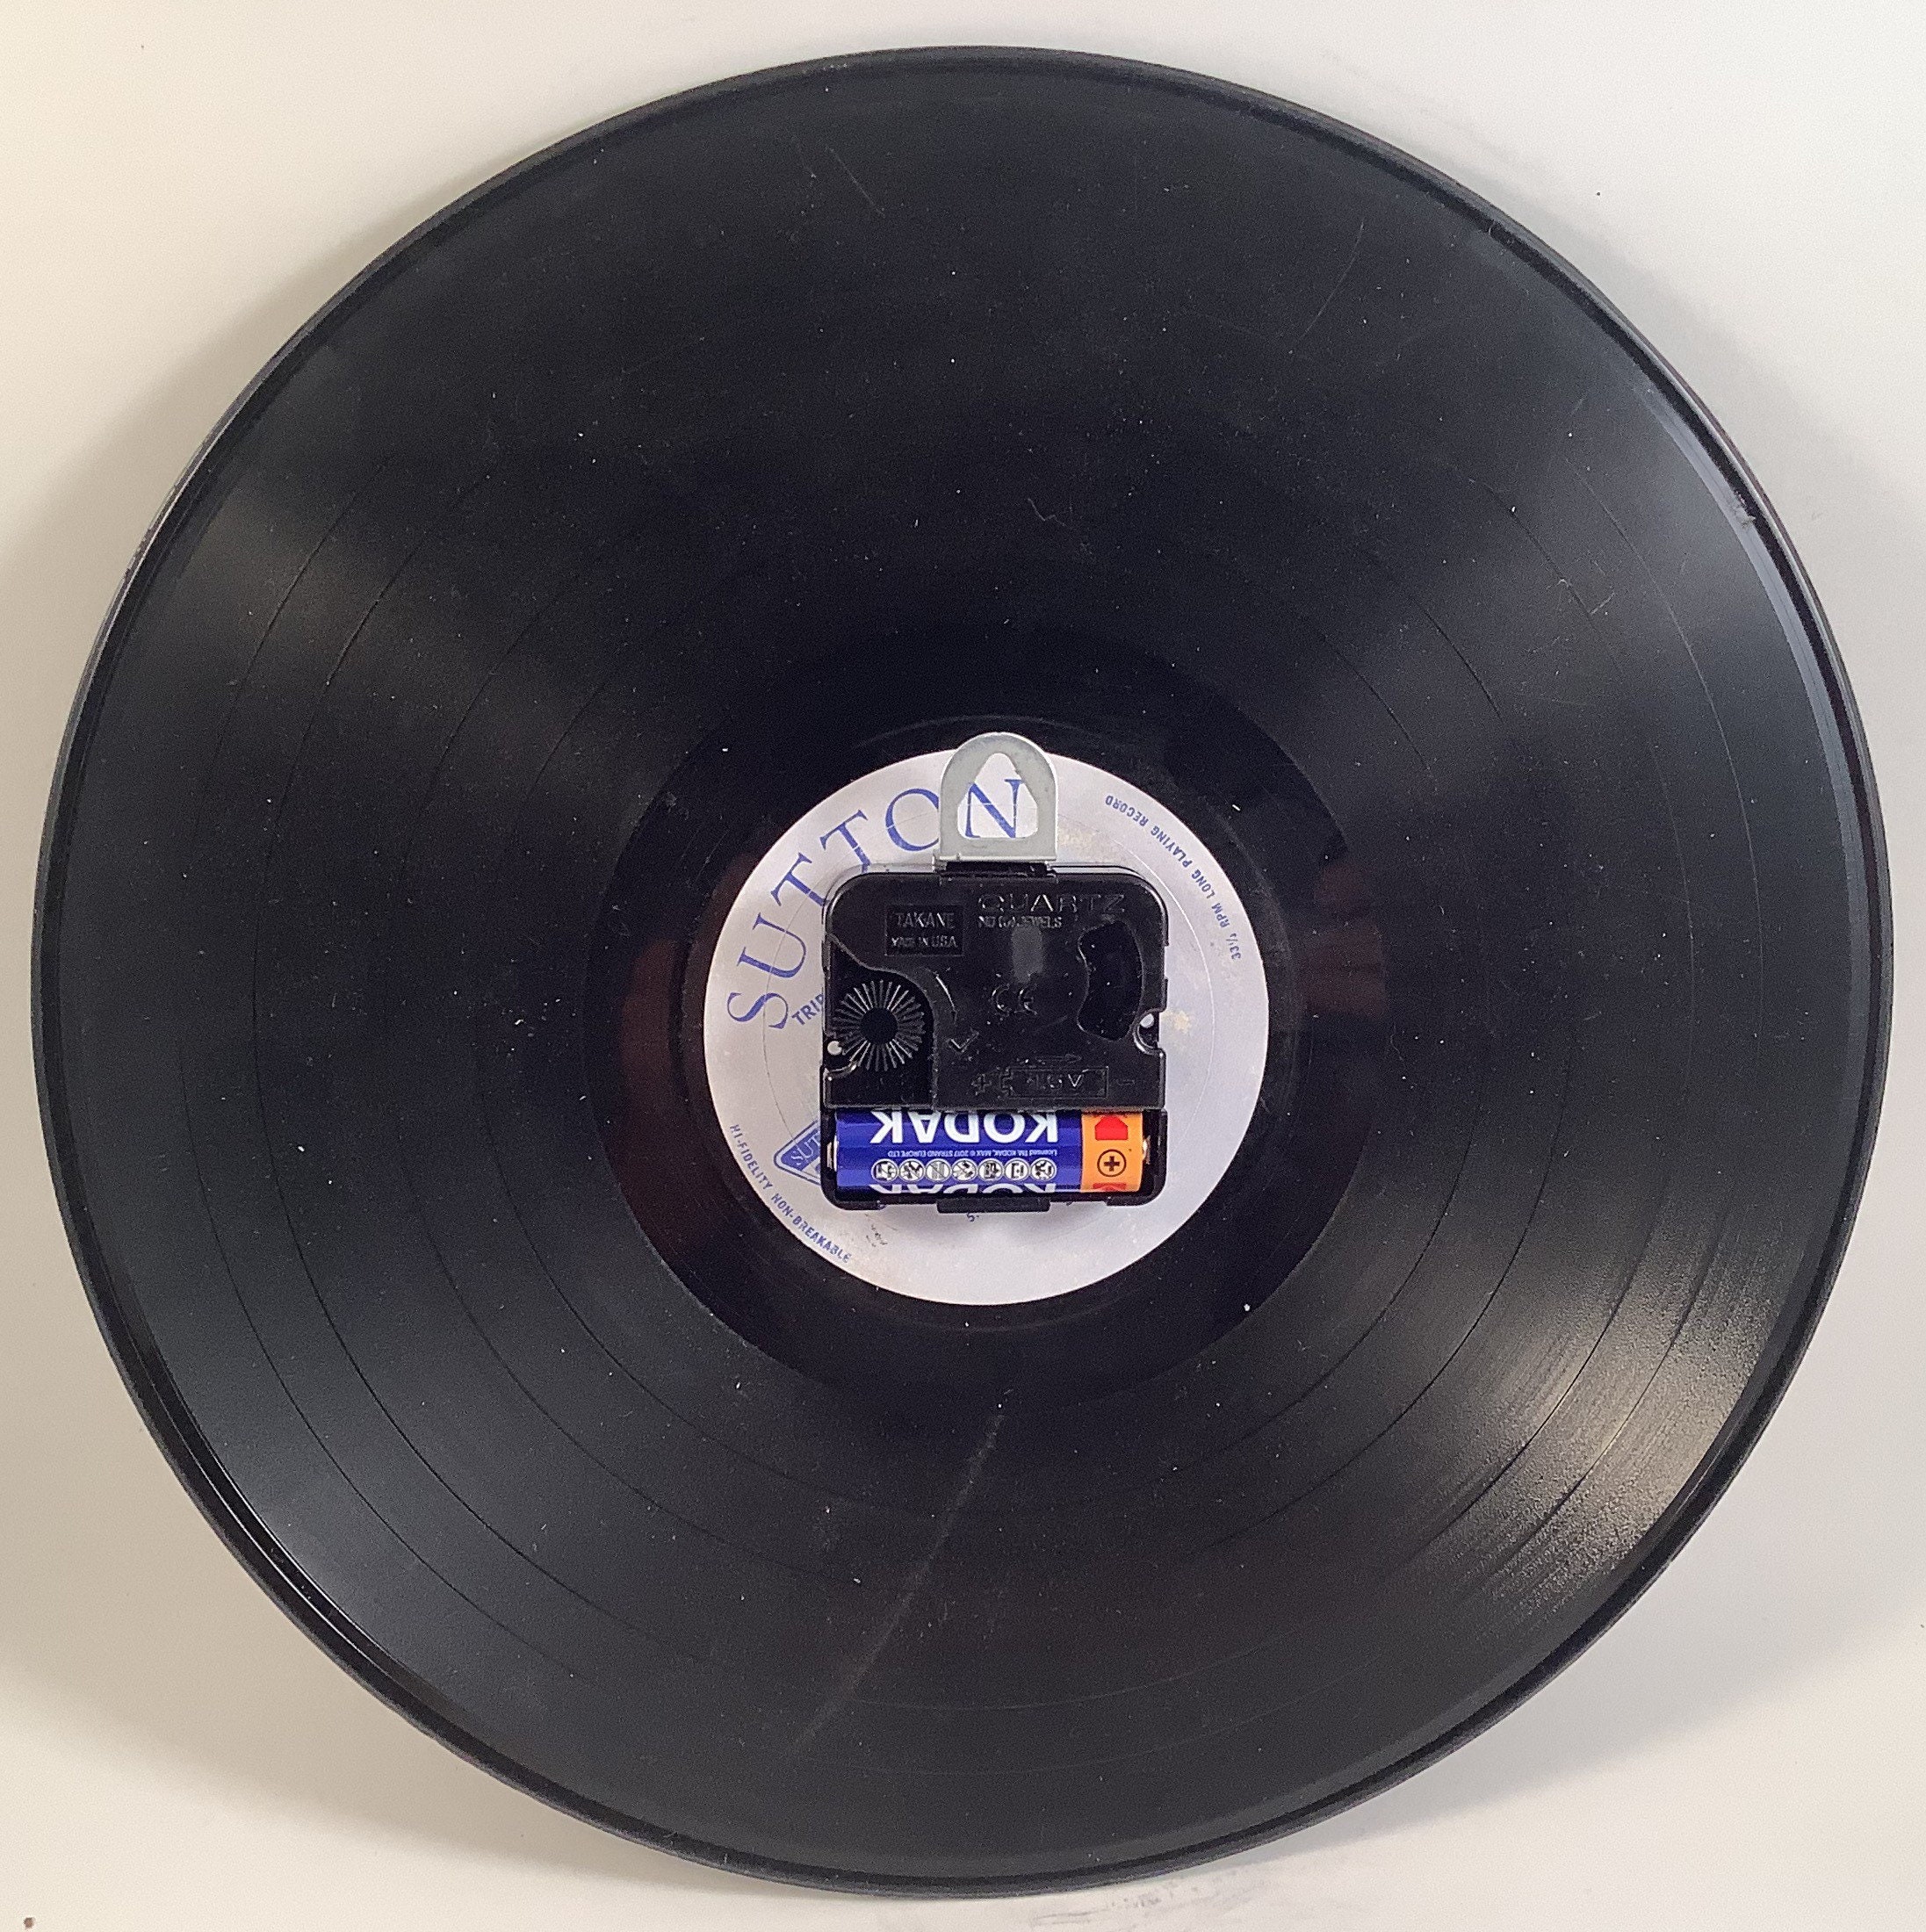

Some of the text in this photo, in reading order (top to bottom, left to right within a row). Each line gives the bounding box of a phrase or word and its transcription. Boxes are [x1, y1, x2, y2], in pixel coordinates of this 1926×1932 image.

[1105, 795, 1149, 827] RECORD
[1151, 825, 1193, 869] PLAYING
[1192, 869, 1215, 899] LONG
[727, 779, 1025, 1029] SUTTON
[977, 893, 1125, 912] QUARTZ
[1212, 903, 1230, 927] RPM
[895, 912, 956, 929] TAKANE
[931, 935, 958, 948] USA
[870, 1110, 1058, 1143] KODAK
[730, 1124, 852, 1264] HI-FIDELITY NON-BREAKABLE
